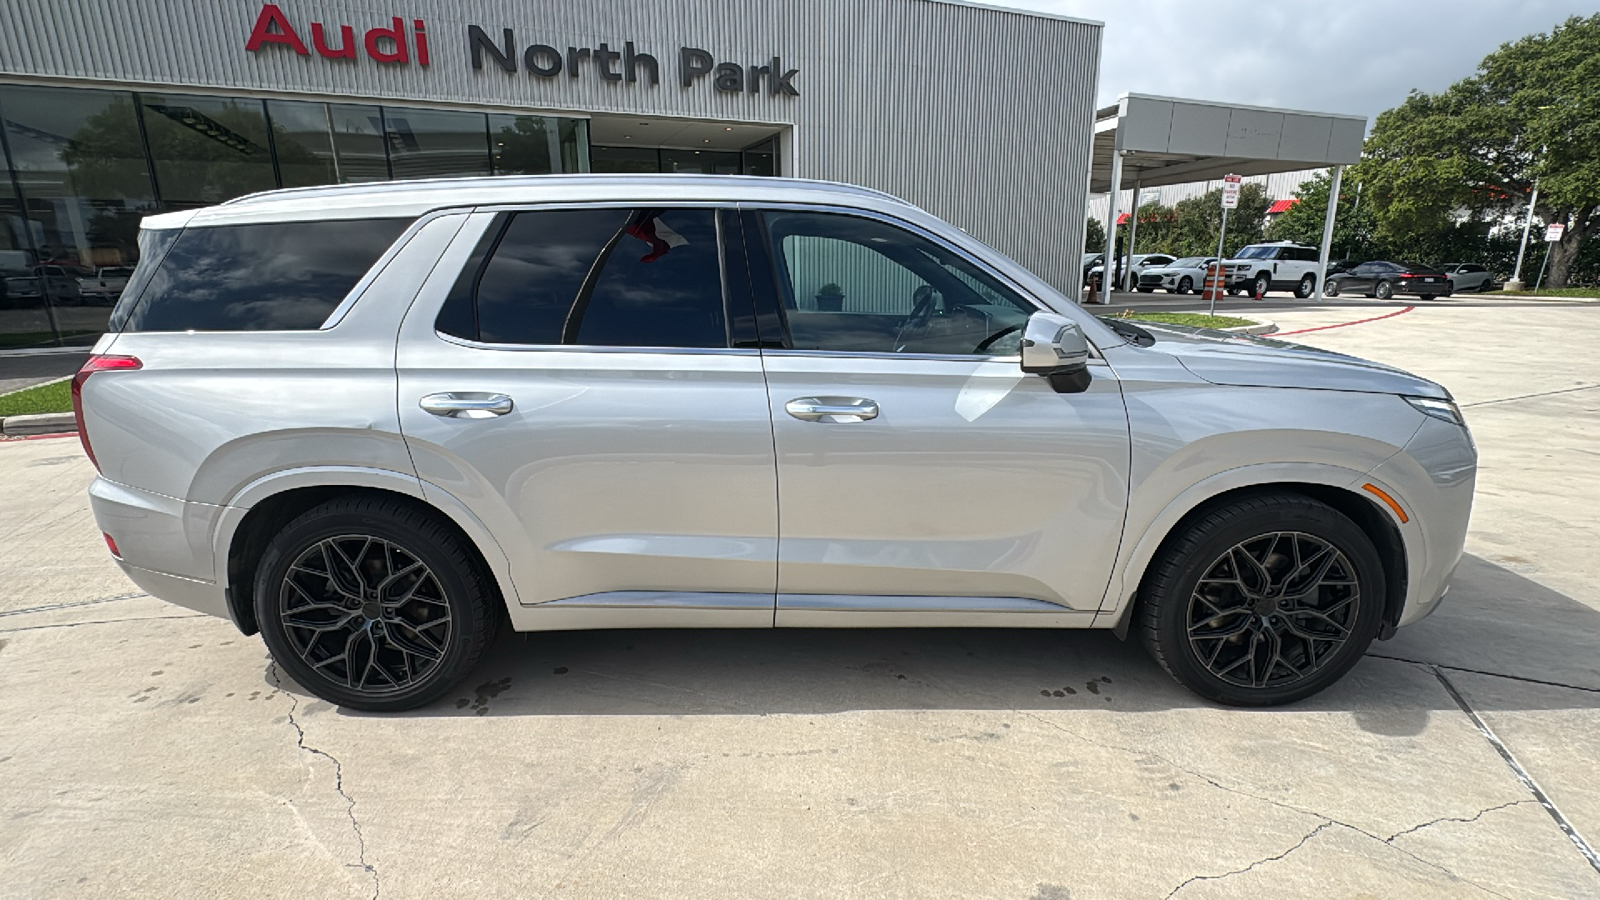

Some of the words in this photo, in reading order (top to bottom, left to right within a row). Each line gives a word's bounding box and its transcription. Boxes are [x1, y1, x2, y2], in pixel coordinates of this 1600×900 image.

[245, 3, 430, 66] Audi
[468, 24, 660, 85] North
[681, 46, 800, 96] Park
